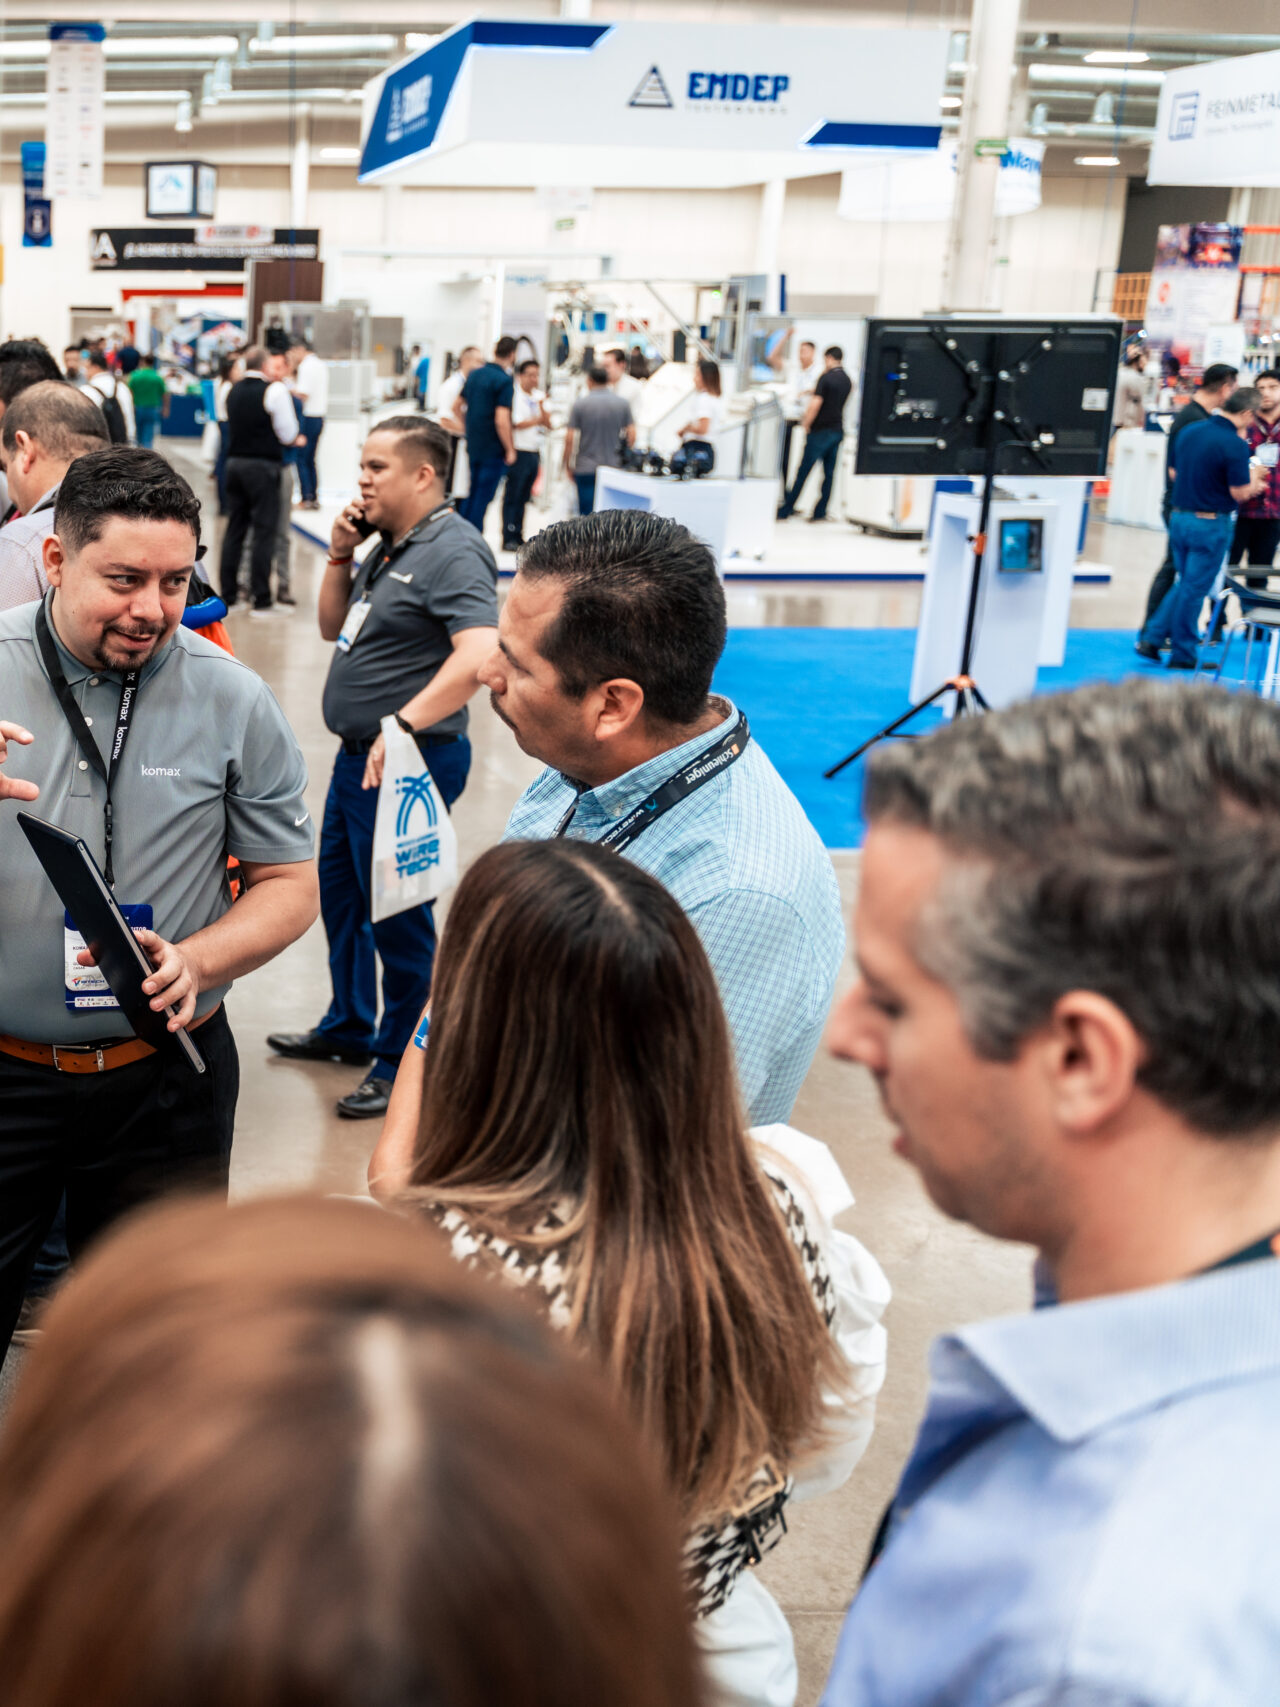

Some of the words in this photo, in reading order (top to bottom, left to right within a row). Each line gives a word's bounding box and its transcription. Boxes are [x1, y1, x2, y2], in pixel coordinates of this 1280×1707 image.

[688, 72, 789, 101] EMDEP
[120, 687, 136, 721] komax
[112, 726, 128, 760] komax
[141, 764, 181, 776] komax
[685, 748, 734, 785] Schleuniger
